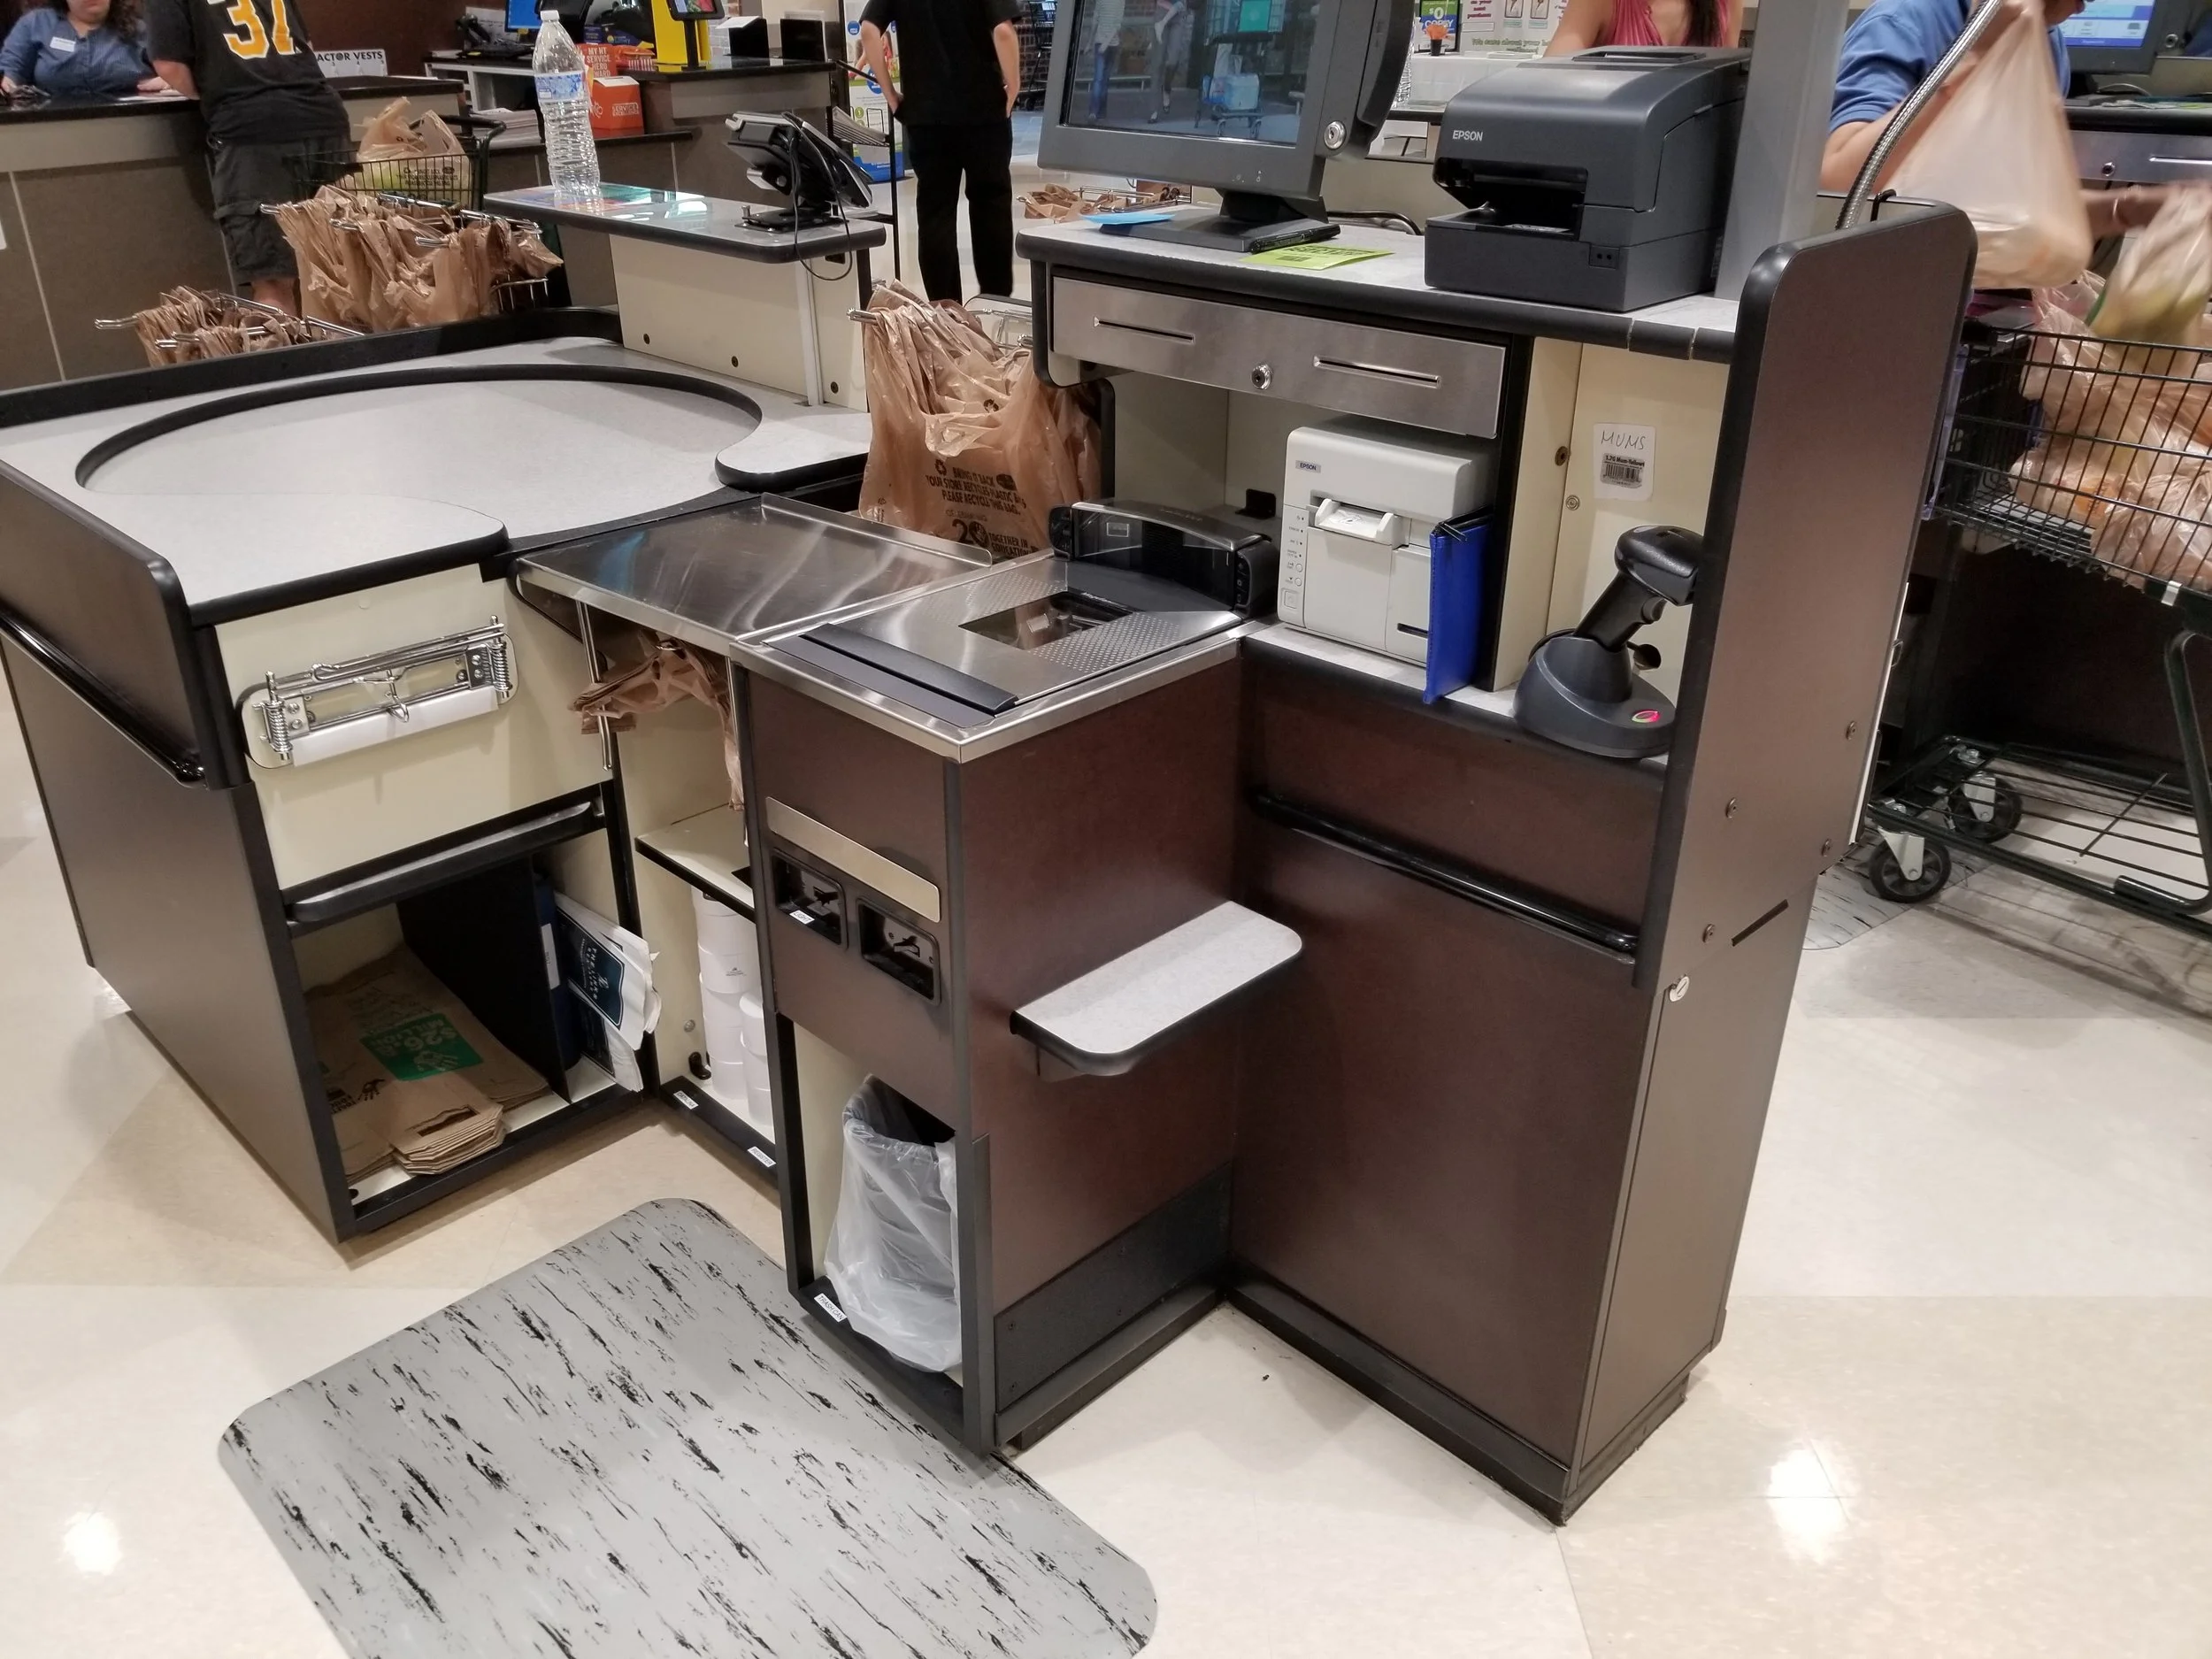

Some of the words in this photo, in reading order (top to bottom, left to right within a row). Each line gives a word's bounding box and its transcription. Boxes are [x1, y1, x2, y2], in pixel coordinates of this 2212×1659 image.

[317, 53, 351, 62] ACTOR
[353, 50, 383, 60] VESTS
[587, 54, 611, 64] SERVICE
[1452, 129, 1484, 142] EPSON
[1601, 430, 1646, 450] MUMS
[1300, 462, 1317, 472] EPSON
[925, 474, 943, 488] YOUR
[943, 477, 964, 491] STORE
[963, 480, 991, 496] RECYCLES
[978, 473, 995, 487] BACK
[941, 488, 964, 503] PLEASE
[964, 493, 991, 508] RECYCLE
[989, 498, 1005, 511] THIS
[951, 518, 991, 549] 20
[988, 533, 1020, 548] TOGETHER
[1020, 538, 1029, 549] IN
[793, 911, 813, 922] LIGHT
[750, 1147, 774, 1166] REGISTER
[818, 1294, 835, 1310] TRASH
[832, 1309, 843, 1320] CAN
